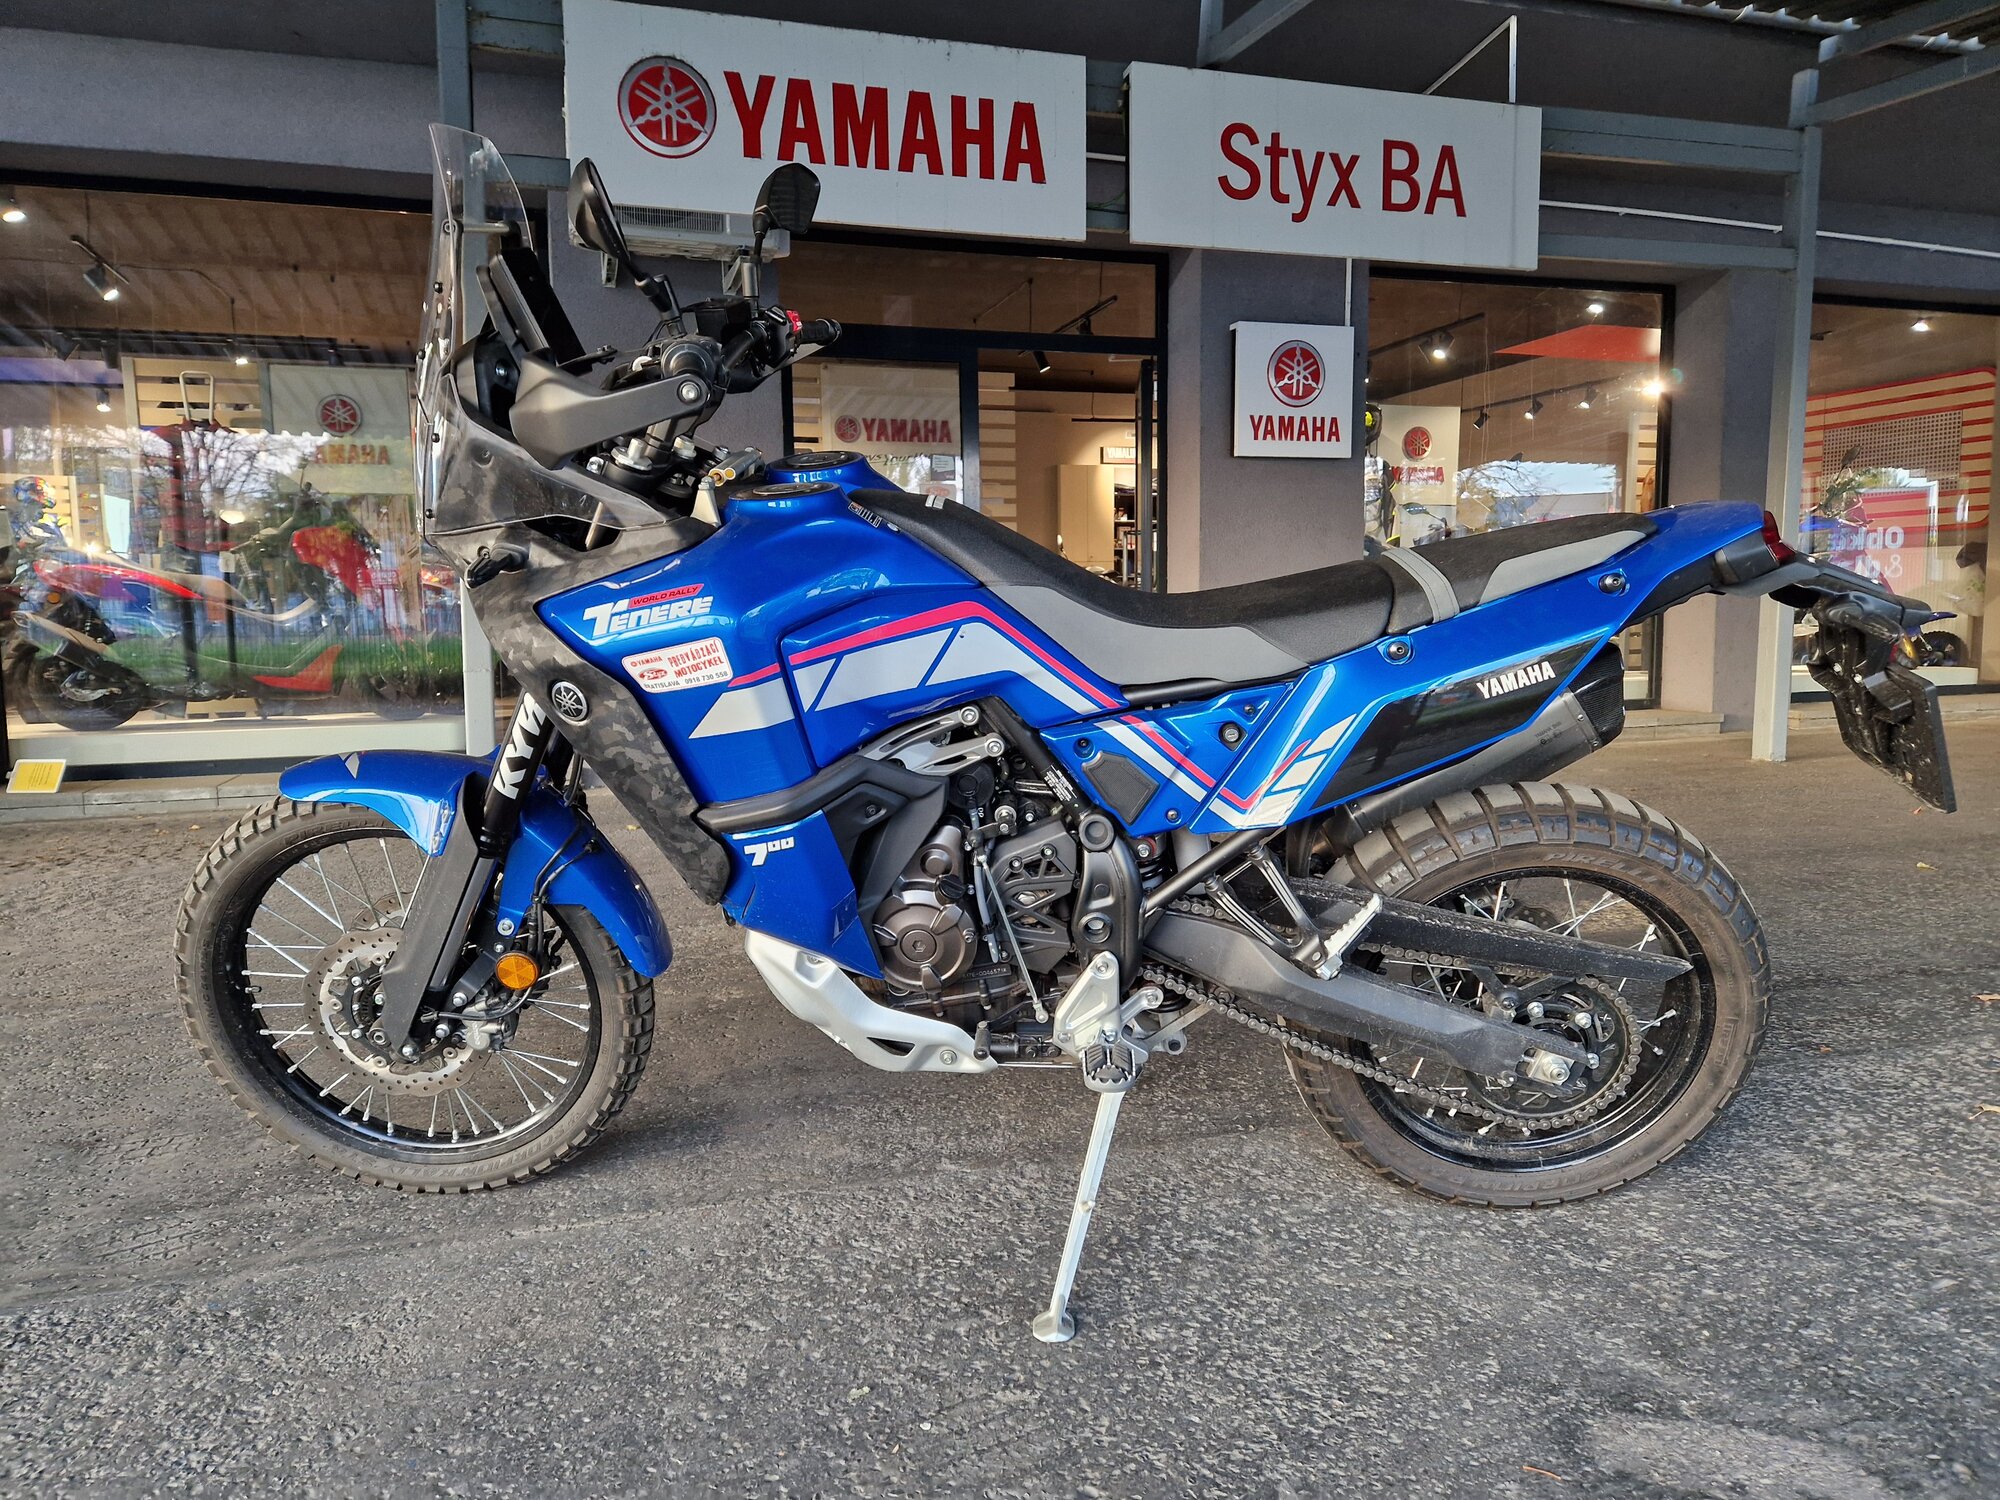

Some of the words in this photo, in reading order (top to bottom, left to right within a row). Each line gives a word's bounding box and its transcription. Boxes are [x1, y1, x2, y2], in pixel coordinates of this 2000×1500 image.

[723, 70, 1047, 184] YAMAHA
[1217, 122, 1361, 223] Styx
[1381, 138, 1467, 218] BA
[861, 417, 952, 444] YAMAHA
[1249, 414, 1341, 442] YAMAHA
[314, 443, 391, 465] AMAHA
[632, 592, 668, 606] WORLD
[668, 585, 699, 598] RALLY
[637, 655, 663, 667] YAMAHA
[667, 640, 720, 668] PREDVÁDZACÍ
[674, 655, 724, 679] MOTOCYKEL
[684, 676, 701, 685] 0918
[702, 674, 714, 683] 730
[715, 670, 729, 680] 558
[1476, 661, 1557, 700] YAMAHA
[743, 836, 795, 867] 700
[1543, 852, 1658, 883] PIRELLI
